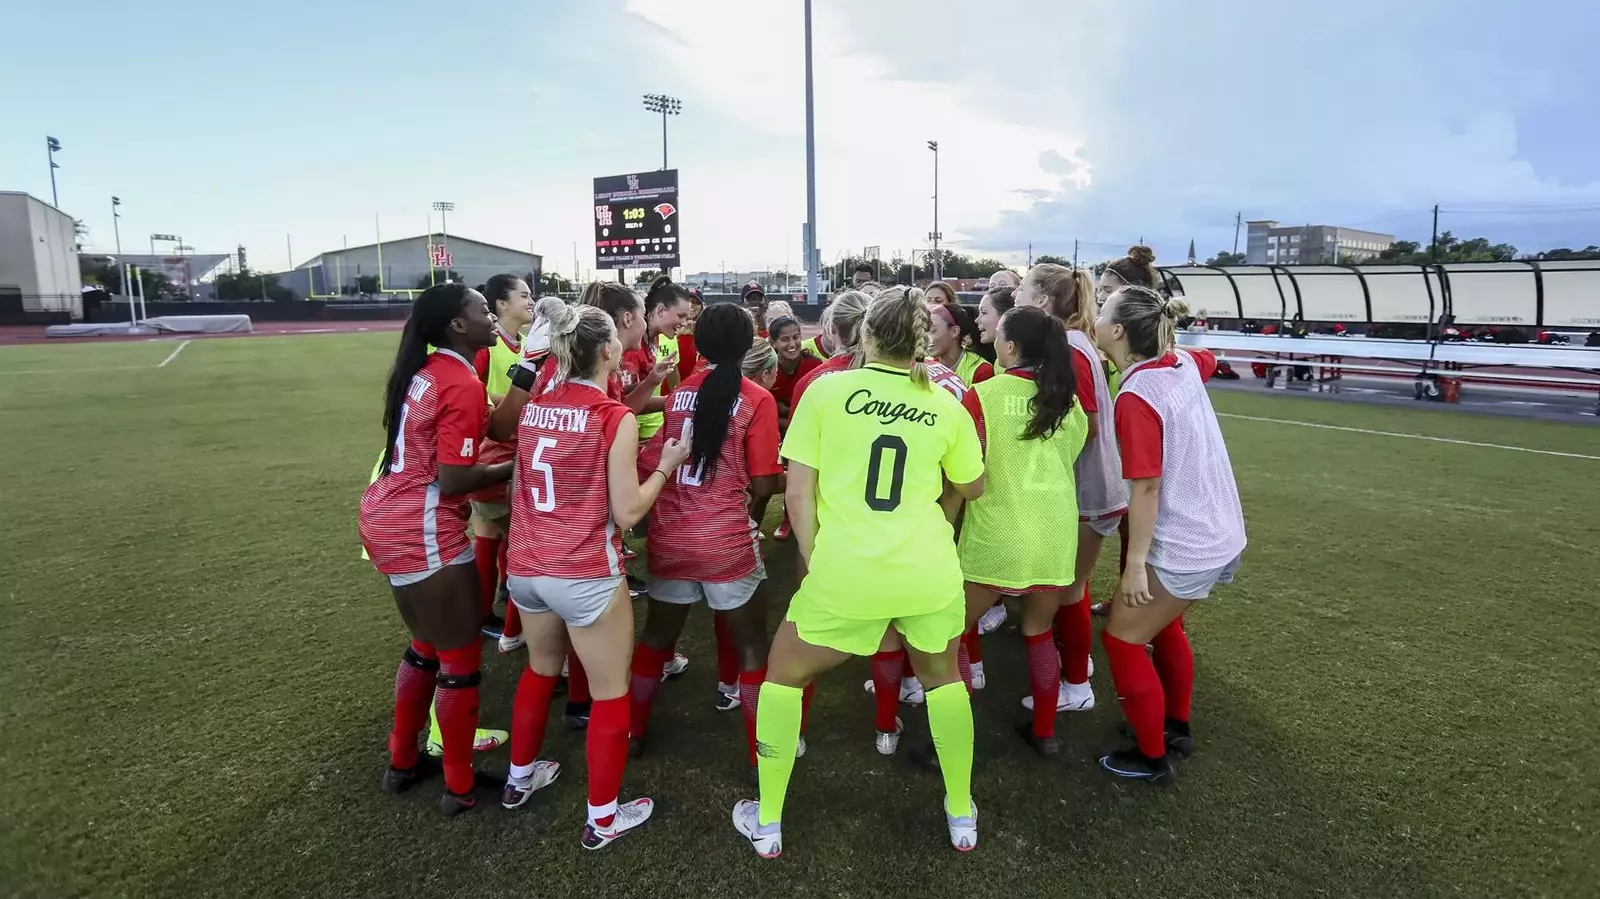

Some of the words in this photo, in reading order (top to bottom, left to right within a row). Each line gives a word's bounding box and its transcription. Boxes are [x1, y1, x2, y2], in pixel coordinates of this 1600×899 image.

[623, 208, 645, 219] 1:03
[427, 244, 453, 267] UH
[521, 403, 589, 433] HOUSTON
[844, 389, 938, 426] Cougars
[531, 436, 558, 512] 5
[865, 434, 908, 512] 0
